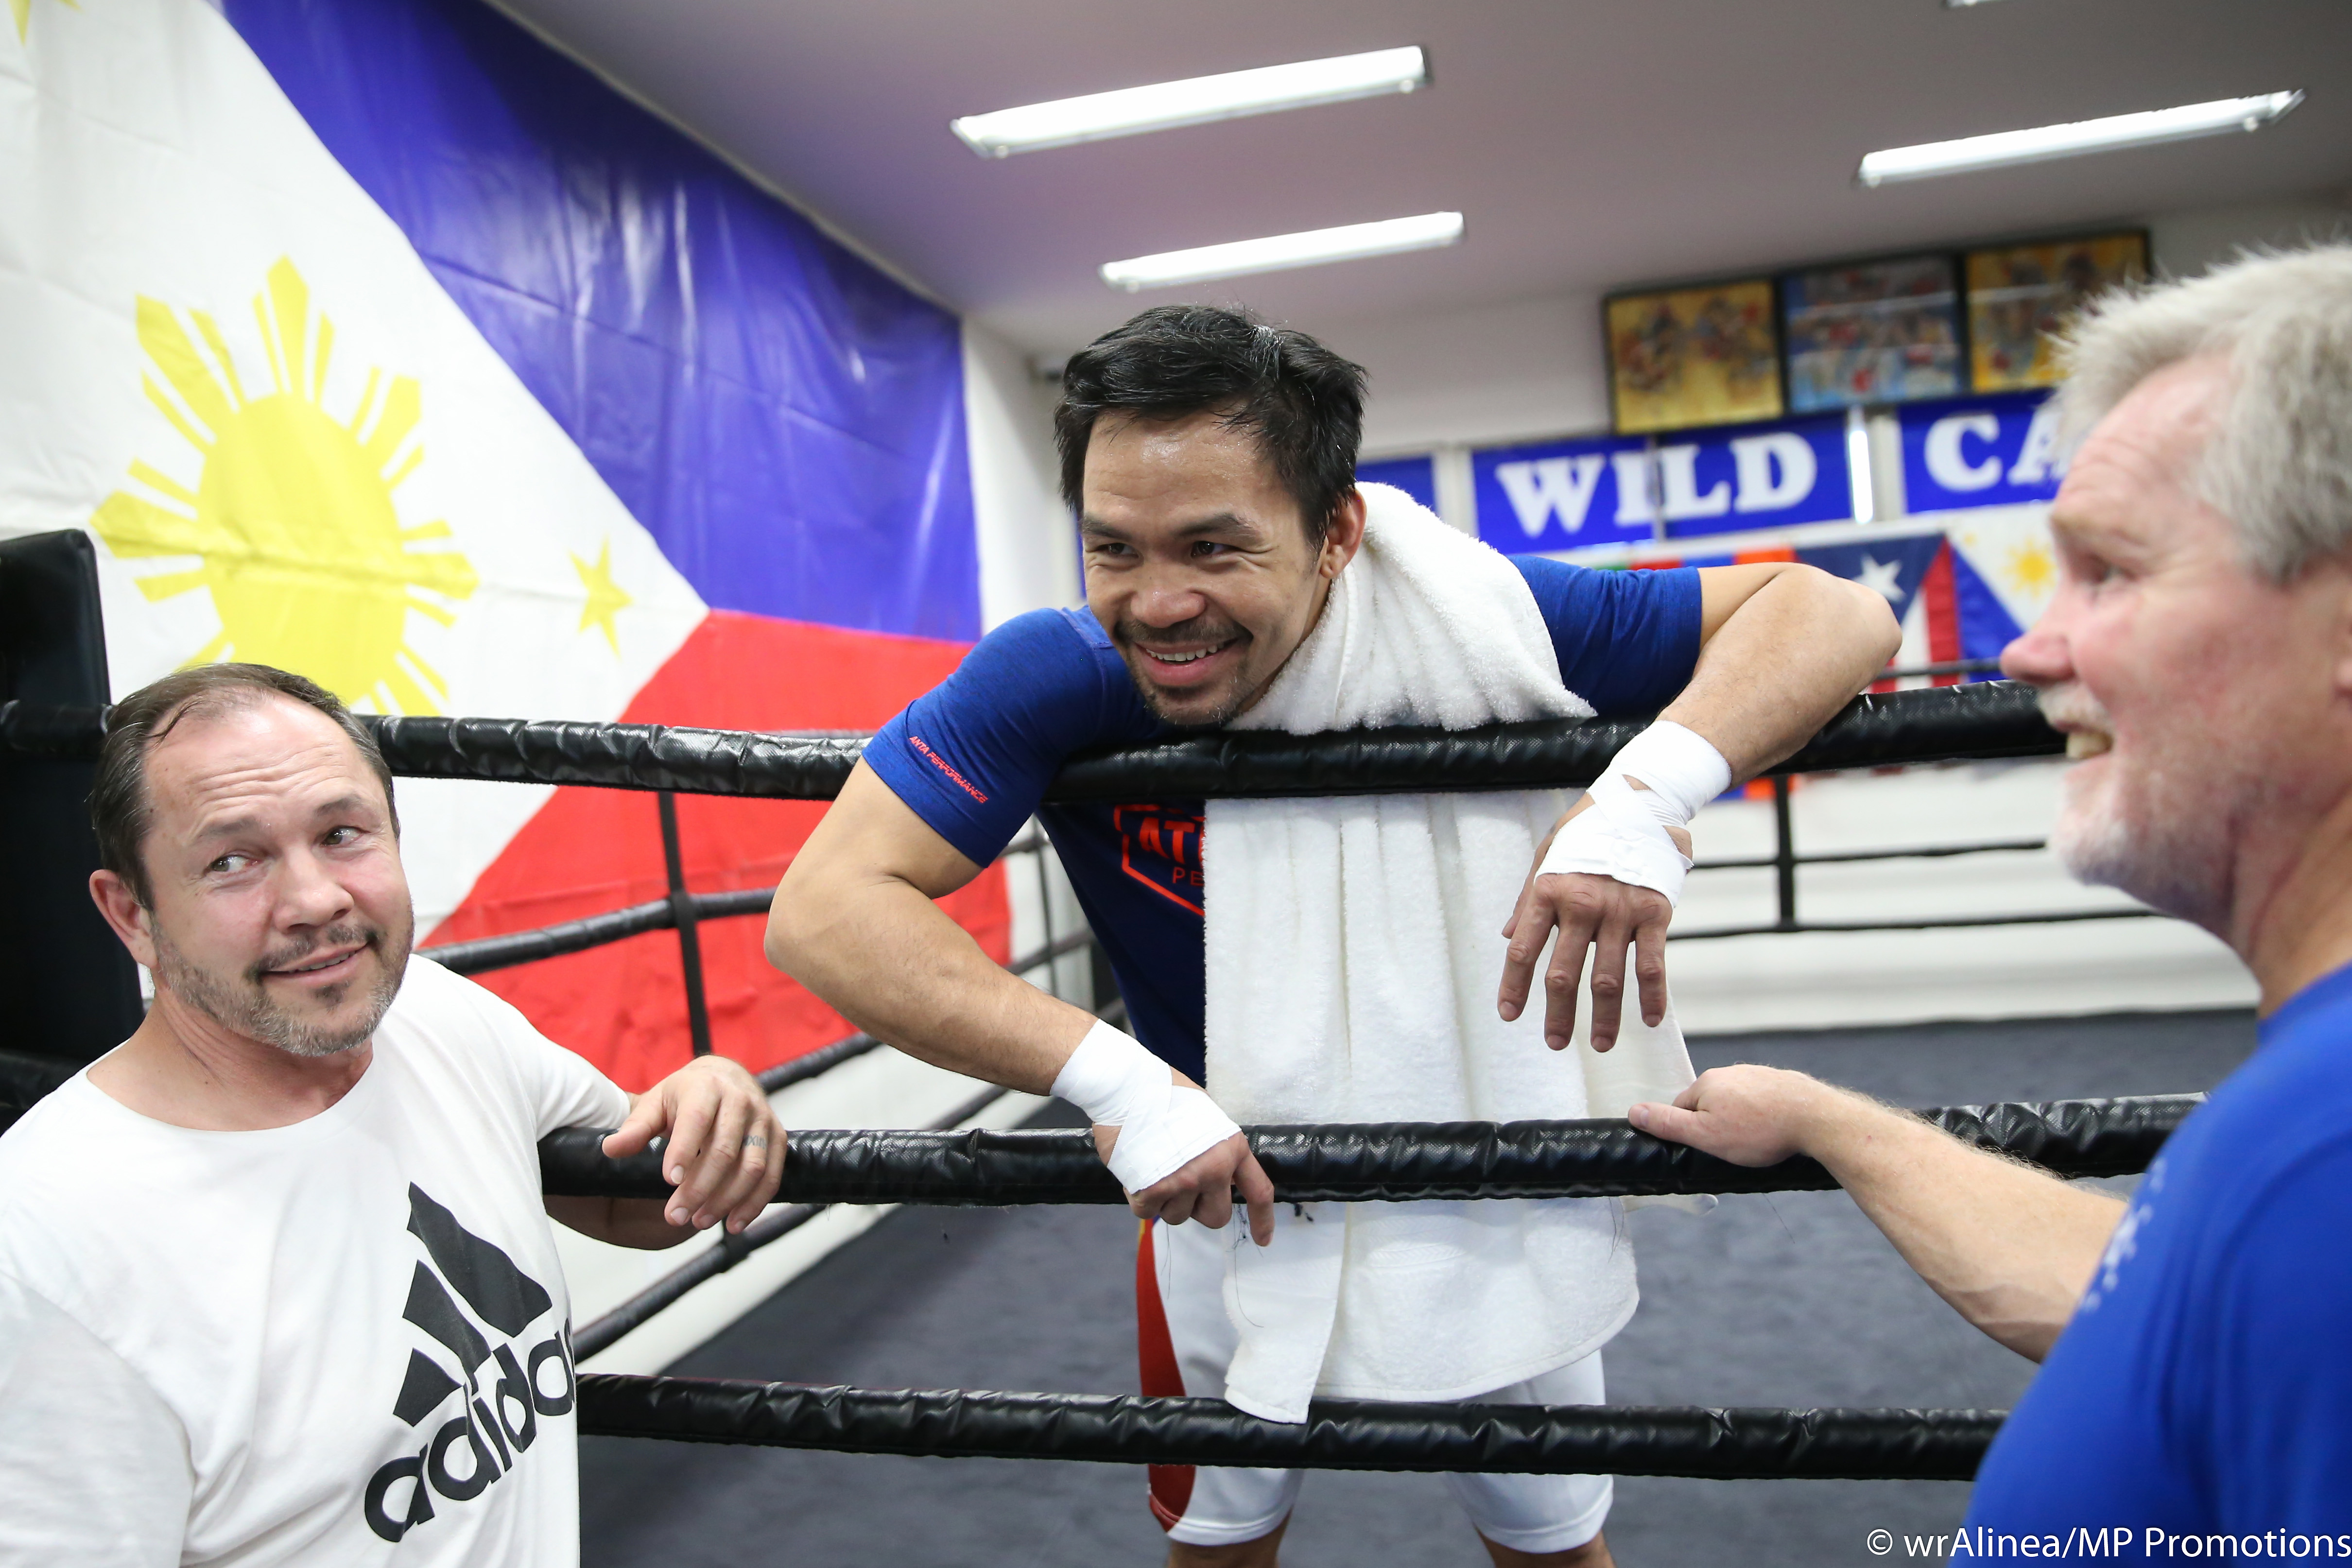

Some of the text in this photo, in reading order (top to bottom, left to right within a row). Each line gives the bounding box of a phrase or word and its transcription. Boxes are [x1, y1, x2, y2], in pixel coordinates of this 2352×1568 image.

[1495, 432, 1817, 537] WILD
[909, 736, 988, 803] ANTA PERFORMANCE
[1139, 816, 1204, 869] AT
